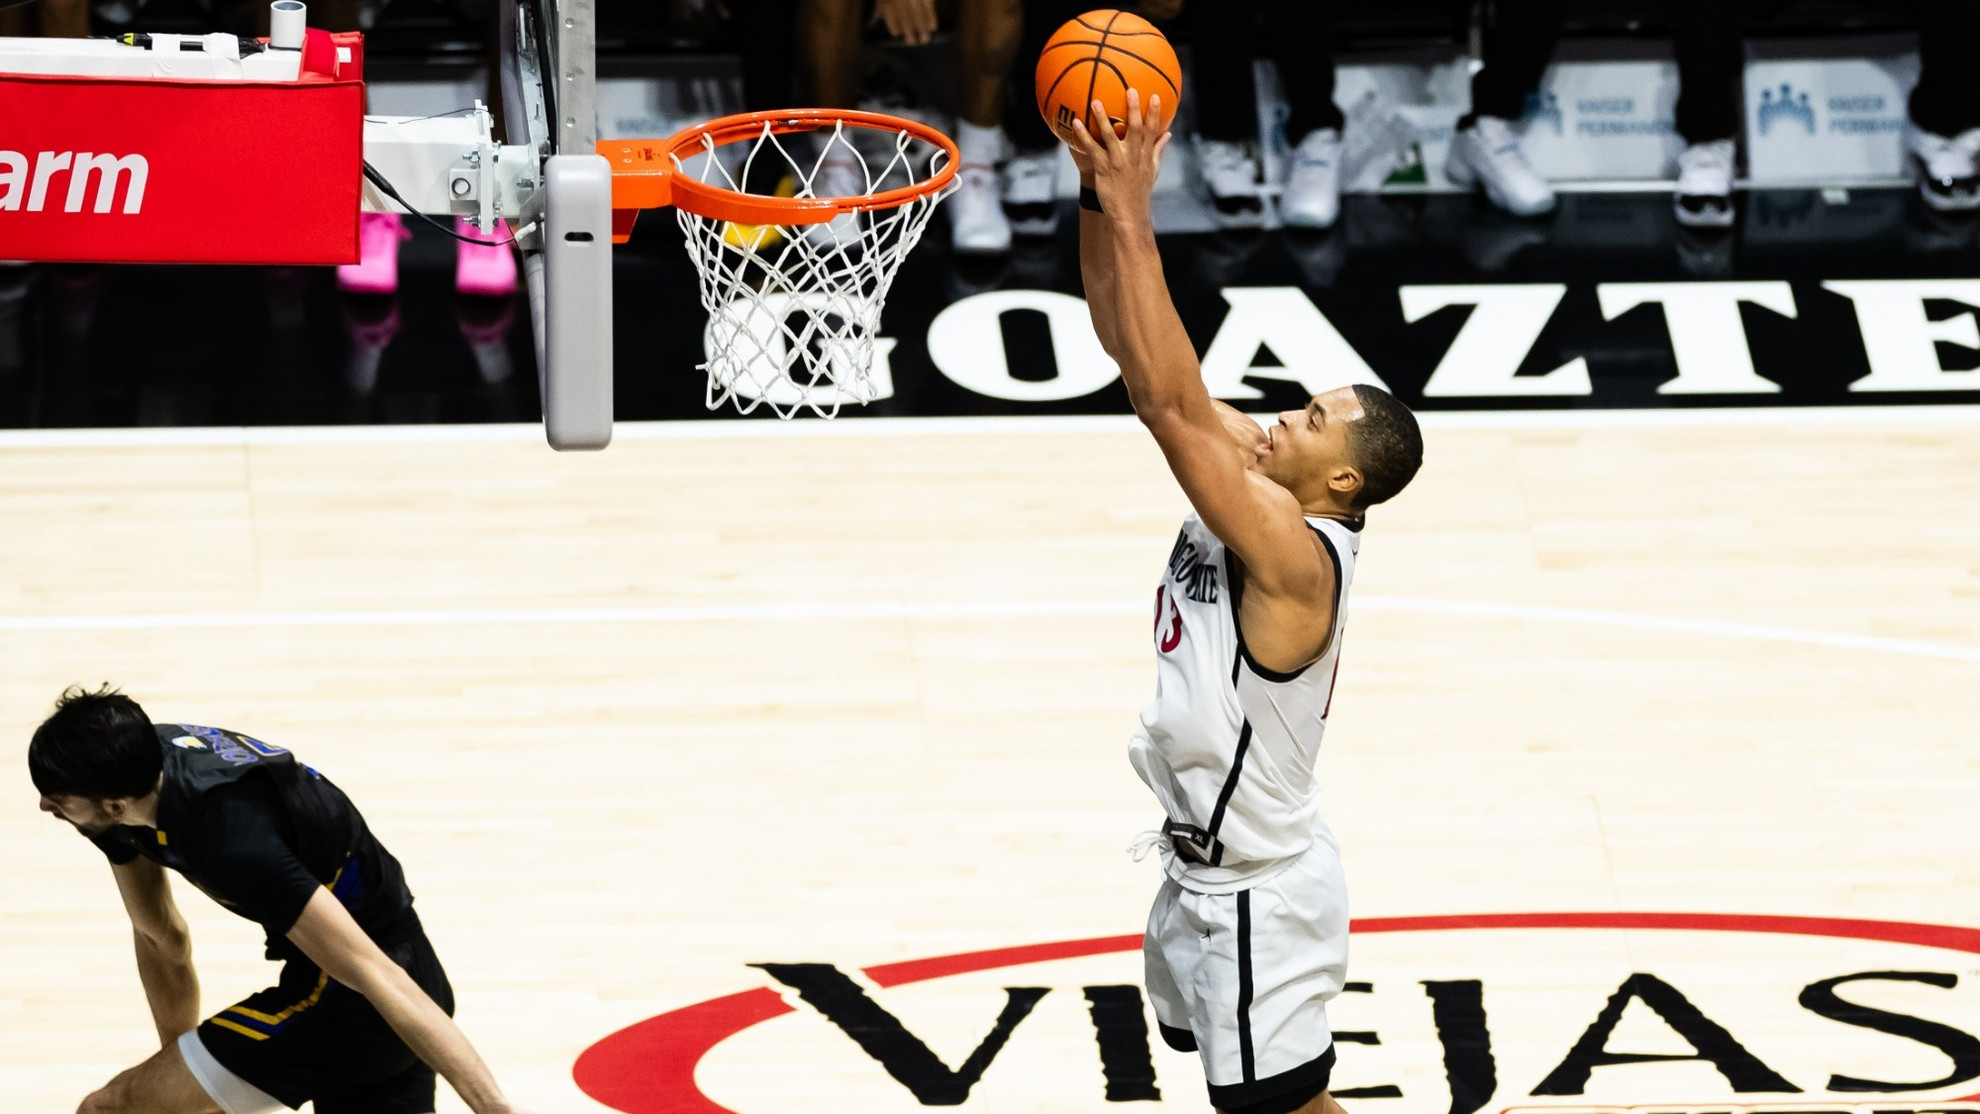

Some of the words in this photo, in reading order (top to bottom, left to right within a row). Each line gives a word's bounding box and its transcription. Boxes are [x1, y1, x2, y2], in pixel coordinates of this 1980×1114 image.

[0, 150, 149, 215] arm
[704, 289, 1122, 405] GO
[1198, 279, 1980, 400] AZTE
